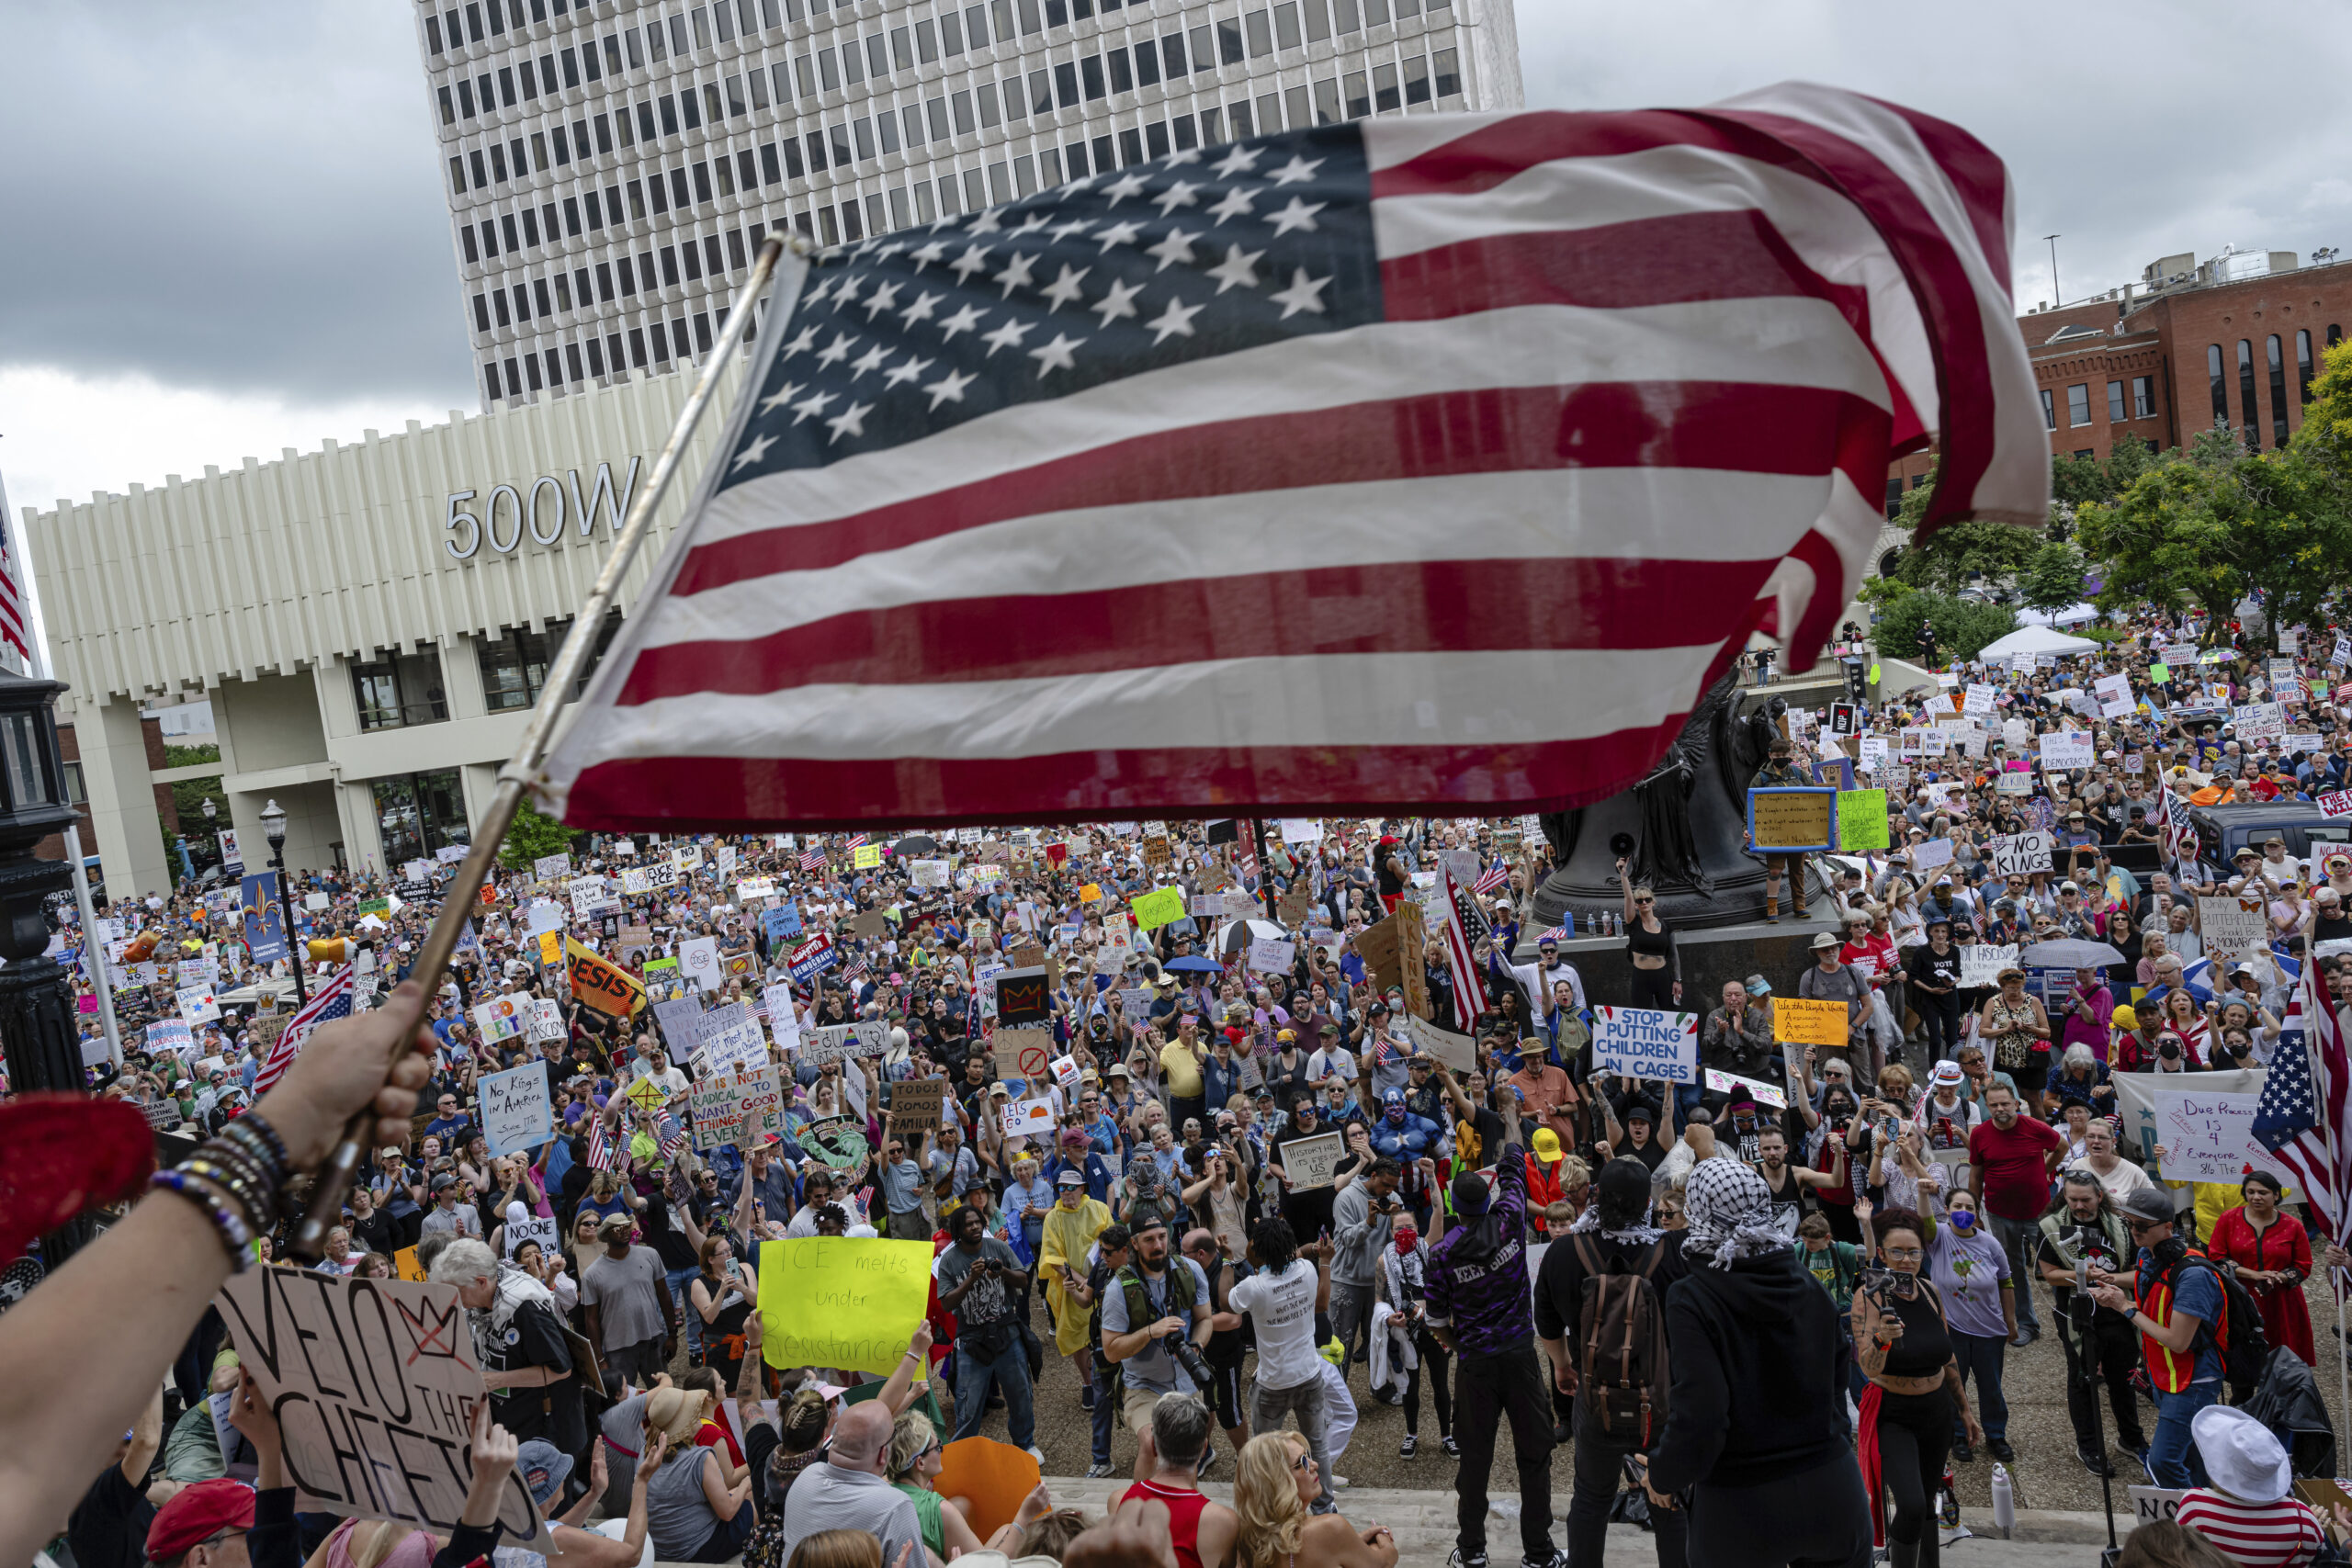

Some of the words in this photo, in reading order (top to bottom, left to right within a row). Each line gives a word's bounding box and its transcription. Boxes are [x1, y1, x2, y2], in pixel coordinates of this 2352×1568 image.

[446, 456, 641, 558] 500W
[1931, 698, 1943, 708] NO
[2278, 693, 2292, 701] DIES!
[2236, 705, 2262, 721] ICE
[2239, 720, 2256, 728] best
[2239, 726, 2282, 738] CRUSHED
[2045, 757, 2089, 769] DEMOCRACY
[1996, 776, 2007, 786] NO
[2318, 792, 2345, 806] THE
[680, 846, 695, 856] NO
[2013, 835, 2041, 854] NO
[2320, 846, 2331, 856] NO
[1148, 854, 1170, 863] 1776
[1996, 852, 2053, 875] KINGS
[647, 863, 673, 878] FUCK
[628, 874, 646, 882] NO
[652, 874, 674, 886] ICE
[571, 884, 584, 894] YOU
[908, 908, 920, 917] NO
[922, 901, 943, 913] KINGS
[1145, 900, 1173, 917] FASCISM
[1279, 897, 1306, 918] RESIST
[2202, 898, 2229, 911] Only
[576, 911, 589, 921] Stop
[1105, 914, 1125, 926] STOP
[1398, 905, 1419, 921] NO
[2201, 913, 2265, 926] BUTTERFLIES
[772, 918, 793, 926] STARTED
[779, 931, 802, 945] MASS
[1108, 928, 1129, 941] INSANITY
[2245, 927, 2257, 935] Be
[253, 942, 280, 952] Downtown
[255, 948, 279, 957] Louisville
[1261, 942, 1283, 950] Cruelty
[691, 955, 709, 964] ICE
[1259, 951, 1283, 959] Christian
[1977, 946, 2016, 961] FASCISM
[792, 949, 833, 977] DEMOCRACY
[1016, 956, 1046, 966] PROCESS
[1406, 926, 1421, 1010] KINGS
[568, 952, 647, 1006] RESIST
[977, 966, 1004, 980] LIBERTY
[122, 976, 148, 987] KINGS
[488, 1000, 514, 1021] DO
[1776, 1000, 1789, 1010] We
[1792, 1001, 1804, 1010] the
[1805, 1001, 1825, 1012] People
[697, 1003, 740, 1026] HISTORY
[1622, 1010, 1663, 1026] STOP
[148, 1022, 164, 1032] THIS
[172, 1020, 187, 1028] WHAT
[150, 1027, 189, 1038] DEMOCRACY
[530, 1021, 567, 1041] FASCISM
[699, 1026, 718, 1041] HAS
[720, 1017, 738, 1031] ITS
[1017, 1020, 1050, 1032] KINGS
[1607, 1022, 1680, 1043] PUTTING
[151, 1038, 173, 1047] LOOKS
[175, 1035, 191, 1044] LIKE
[710, 1038, 722, 1054] At
[724, 1032, 742, 1047] most
[745, 1028, 757, 1037] he
[805, 1050, 834, 1066] HURTS
[840, 1049, 854, 1060] NO
[863, 1043, 882, 1057] ONE
[1596, 1039, 1678, 1059] CHILDREN
[1606, 1058, 1622, 1073] IN
[1633, 1060, 1688, 1079] CAGES
[490, 1082, 503, 1099] No
[511, 1074, 540, 1091] Kings
[693, 1080, 706, 1094] IT
[715, 1078, 726, 1089] IS
[737, 1069, 765, 1086] NOT
[692, 1089, 741, 1108] RADICAL
[752, 1081, 771, 1092] TO
[897, 1085, 938, 1094] TODOS
[505, 1094, 543, 1113] AMERICA
[693, 1103, 732, 1121] WANT
[741, 1093, 778, 1111] GOOD
[896, 1101, 937, 1112] SOMOS
[1002, 1102, 1027, 1119] LETS
[2184, 1099, 2213, 1116] Due
[2218, 1102, 2254, 1115] Process
[497, 1122, 522, 1134] Since
[524, 1116, 537, 1125] 1776
[695, 1113, 743, 1131] THINGS
[893, 1117, 936, 1130] FAMILIA
[1006, 1119, 1021, 1129] GO
[2209, 1133, 2219, 1145] 4
[1287, 1146, 1322, 1159] HISTORY
[2188, 1147, 2239, 1160] Everyone
[2246, 1141, 2278, 1164] Remove
[811, 1164, 841, 1173] FIGHTING
[1309, 1164, 1326, 1173] US
[2200, 1163, 2214, 1175] 86
[1296, 1179, 1308, 1188] NO
[1310, 1175, 1334, 1185] KINGS
[509, 1224, 530, 1238] NO
[528, 1221, 553, 1235] ONE
[781, 1241, 831, 1272] ICE
[855, 1254, 908, 1274] melts
[1453, 1264, 1486, 1283] KEEP
[1489, 1238, 1521, 1271] GOING
[816, 1290, 868, 1306] under
[761, 1313, 908, 1361] Resistance
[220, 1264, 413, 1425] VETO
[414, 1383, 475, 1439] THE
[2139, 1496, 2180, 1519] NO
